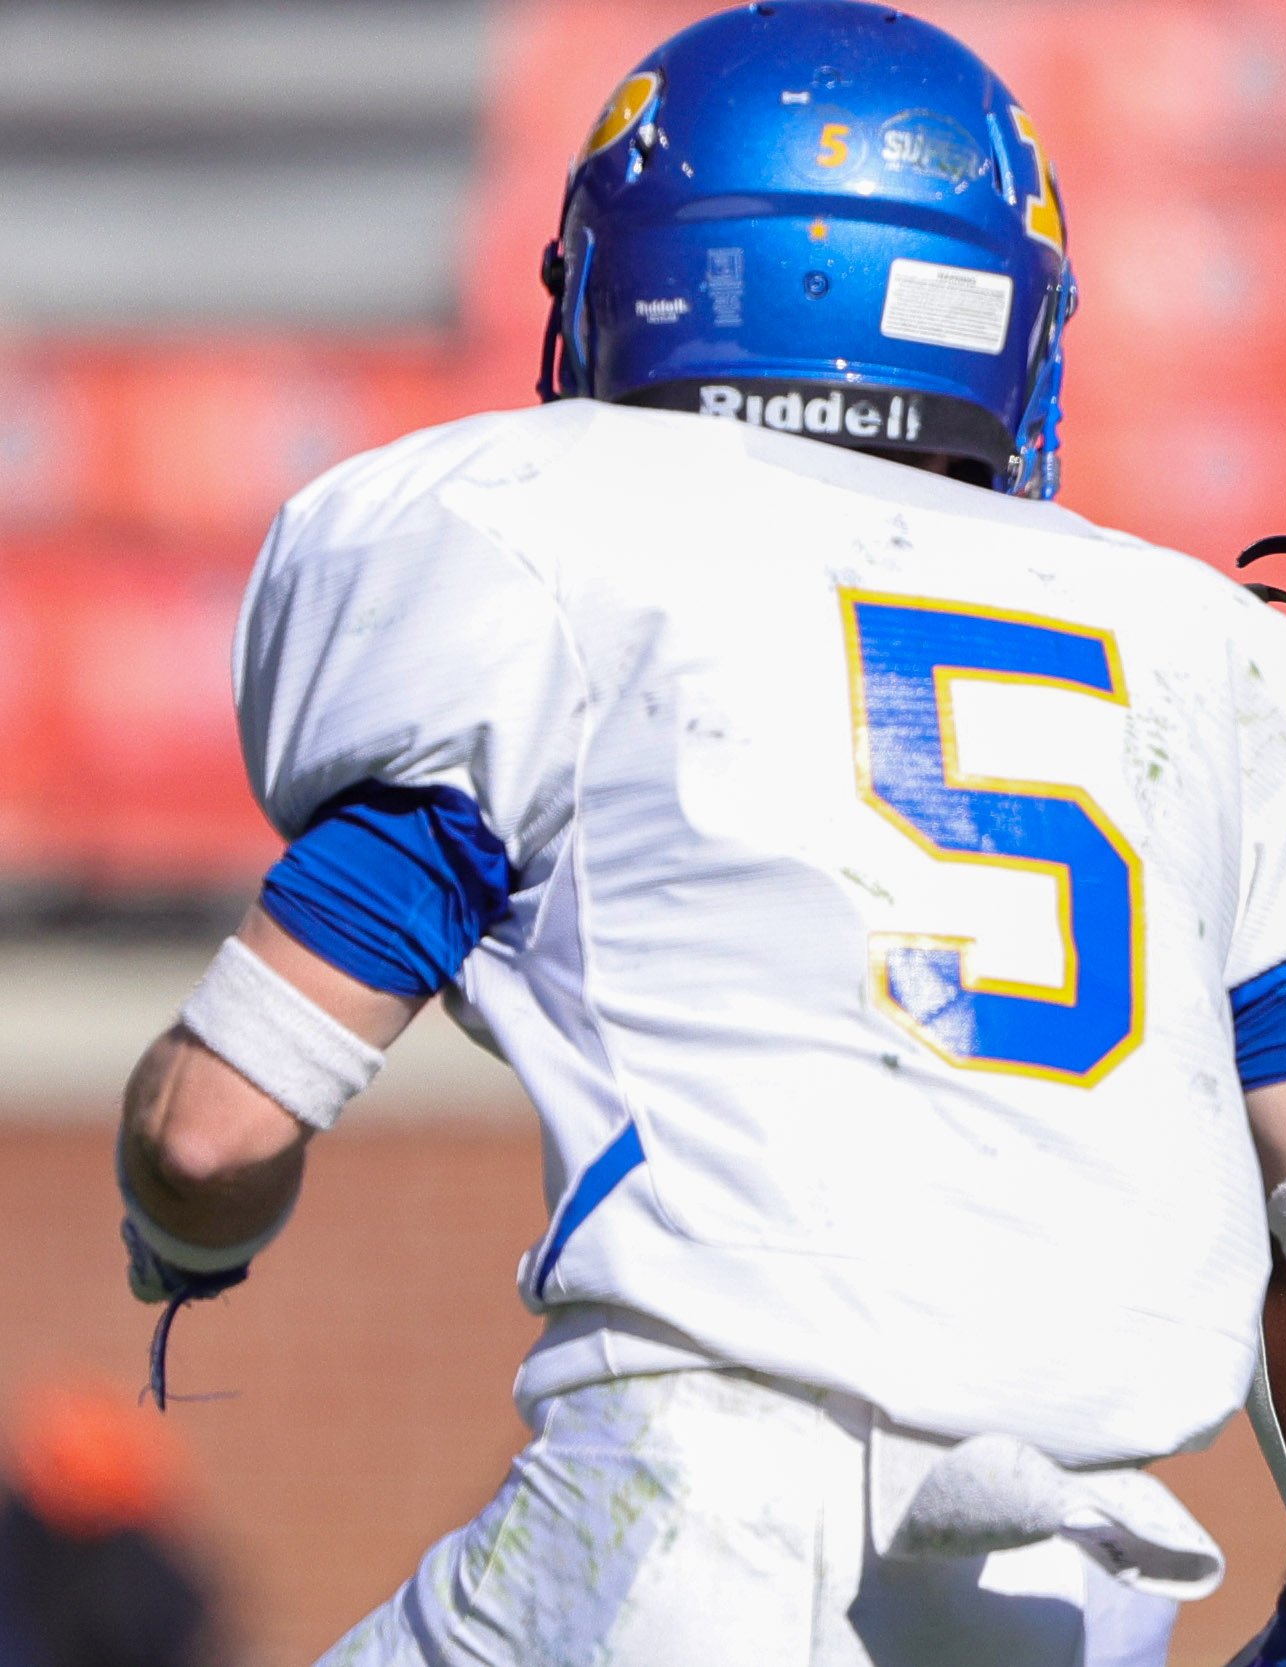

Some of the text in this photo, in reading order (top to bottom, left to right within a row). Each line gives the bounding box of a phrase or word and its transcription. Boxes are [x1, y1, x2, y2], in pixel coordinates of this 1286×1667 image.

[817, 122, 851, 169] 5
[700, 384, 922, 441] Riddell
[836, 584, 1147, 1091] 5
